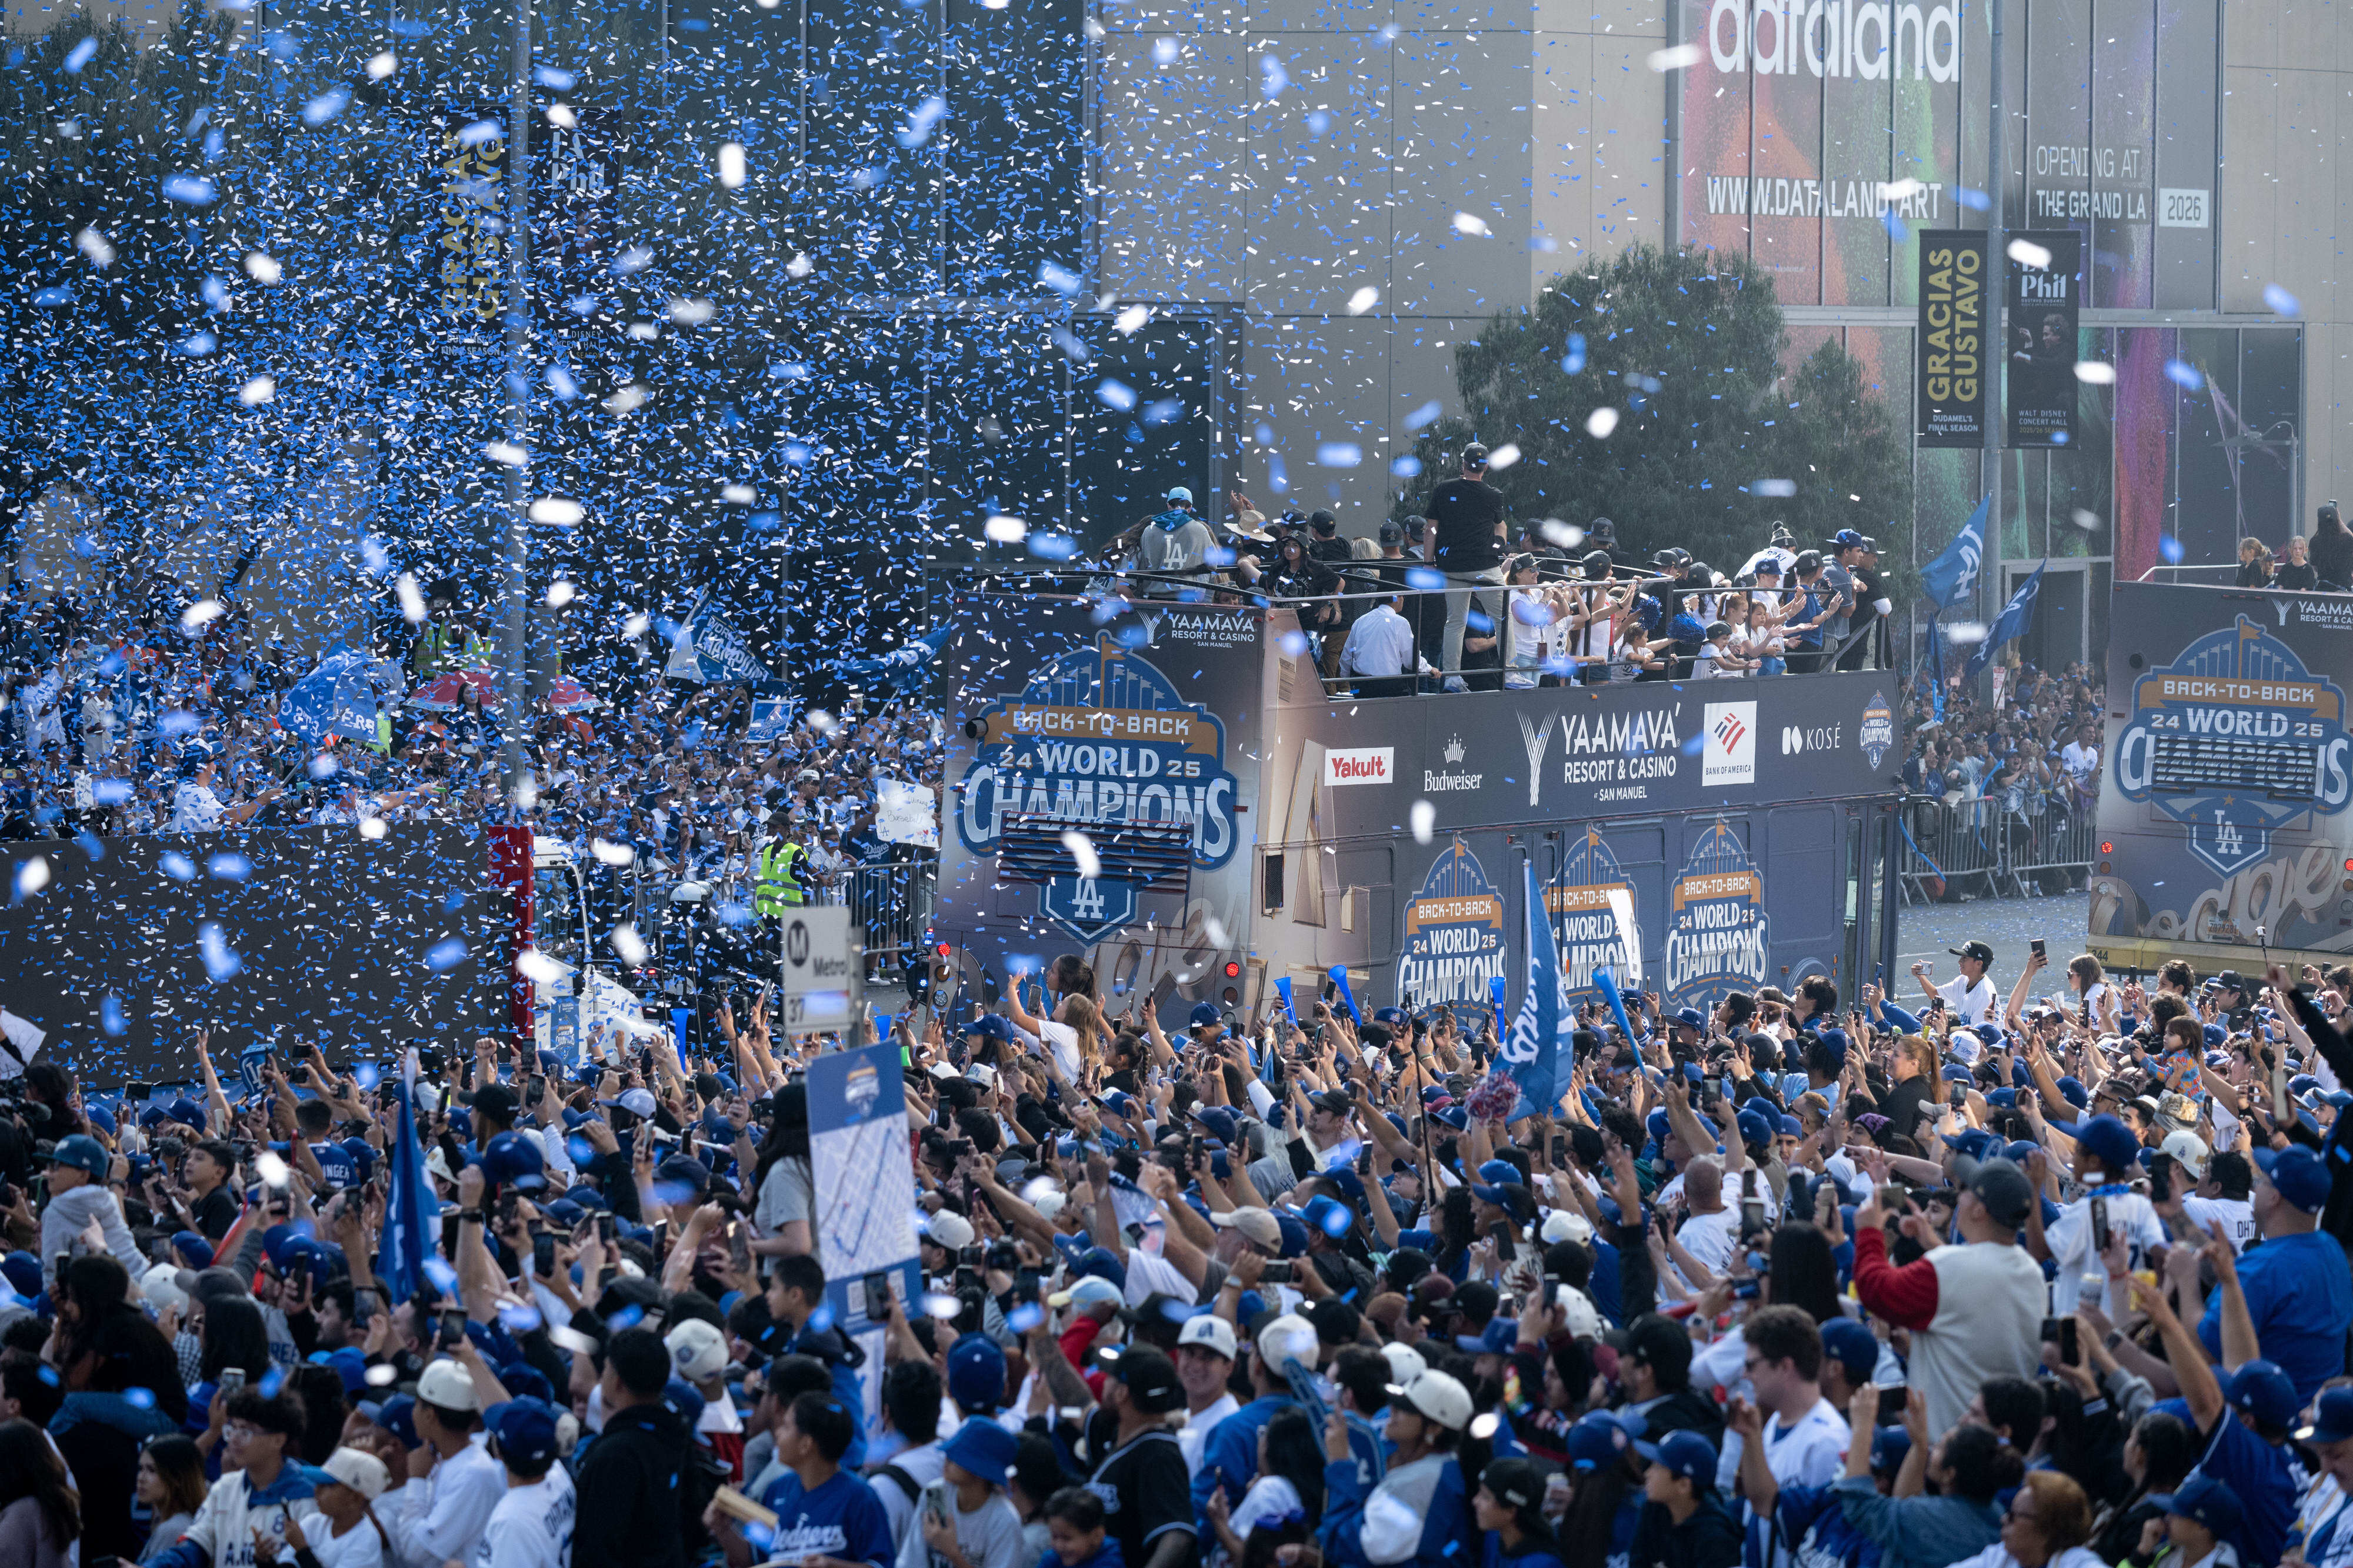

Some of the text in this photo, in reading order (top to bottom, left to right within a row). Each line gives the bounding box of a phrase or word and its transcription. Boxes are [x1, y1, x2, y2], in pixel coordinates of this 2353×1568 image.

[1709, 0, 1959, 83] dataland
[2037, 146, 2141, 179] OPENING AT
[1707, 176, 1941, 219] WWW.DATALAND.ART
[2036, 190, 2146, 219] THE GRAND LA
[2168, 195, 2201, 221] 2026
[2021, 273, 2066, 298] Phil
[1928, 249, 1952, 401] GRACIAS
[1954, 249, 1980, 402] GUSTAVO
[1933, 415, 1973, 423] DUDAMEL'S
[1172, 630, 1208, 639] RESORT
[1219, 633, 1255, 642] CASINO
[2164, 680, 2314, 702] BACK-TO-BACK
[1013, 710, 1190, 735] BACK-TO-BACK
[1807, 721, 1841, 750] KOSÉ
[1861, 725, 1892, 746] CHAMPIONS
[2151, 708, 2324, 737] 24 WORLD 25
[1000, 743, 1201, 778] 24 WORLD 25
[1331, 756, 1386, 778] Yakult
[1564, 756, 1677, 783] RESORT & CASINO
[1705, 764, 1751, 776] BANK OF AMERICA
[1424, 769, 1482, 792] Budweiser
[1599, 788, 1615, 801] SAN
[1617, 786, 1647, 800] MANUEL
[964, 765, 1231, 858] CHAMPIONS
[1685, 876, 1751, 895] BACK-TO-BACK
[1419, 900, 1492, 919] BACK-TO-BACK
[1679, 902, 1755, 930] 24 WORLD 25
[1413, 940, 1428, 954] 24
[1430, 928, 1479, 955] WORLD
[1565, 915, 1612, 942] WORLD
[814, 957, 849, 978] Metro
[1666, 920, 1765, 992] CHAMPIONS
[1398, 946, 1505, 1012] CHAMPIONS
